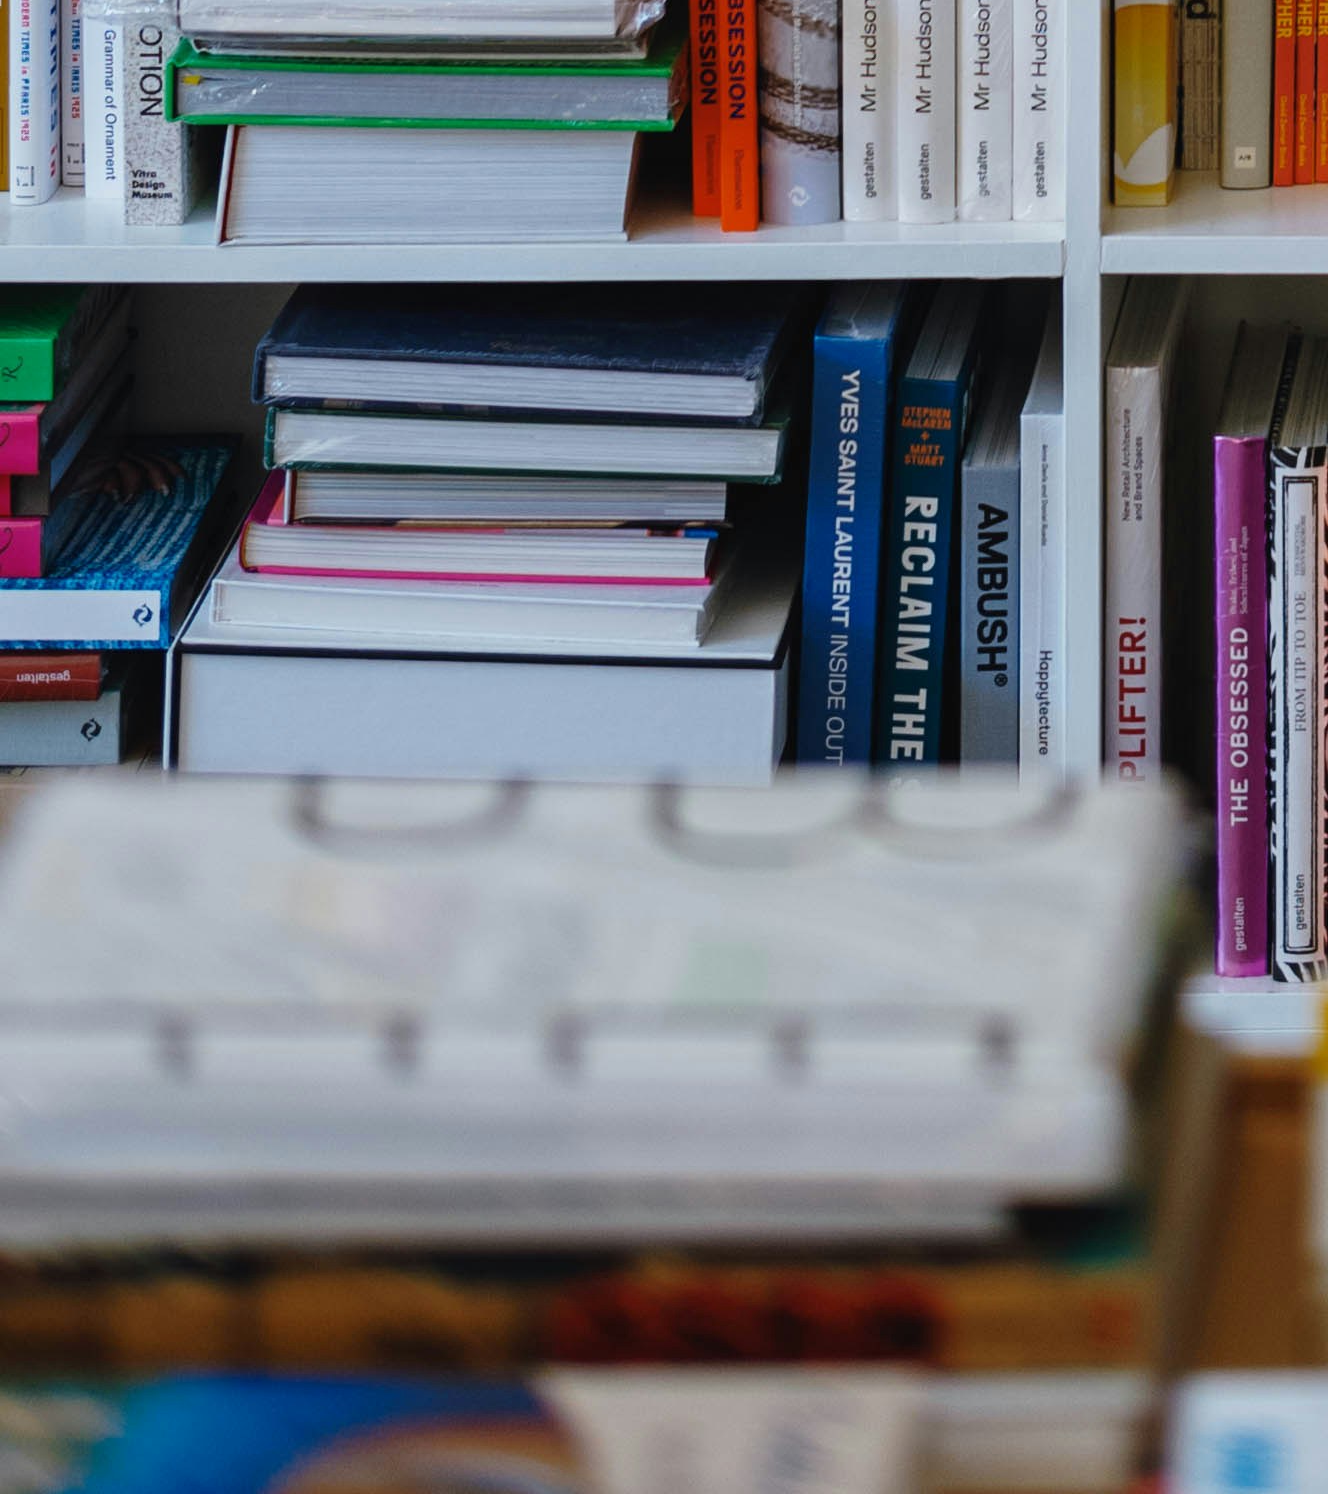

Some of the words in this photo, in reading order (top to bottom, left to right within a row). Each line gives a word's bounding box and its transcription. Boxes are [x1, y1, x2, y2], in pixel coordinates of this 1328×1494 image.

[895, 497, 936, 670] RECLAIM
[890, 689, 926, 761] THE
[1229, 628, 1249, 770] OBSESSED
[1230, 784, 1248, 826] THE
